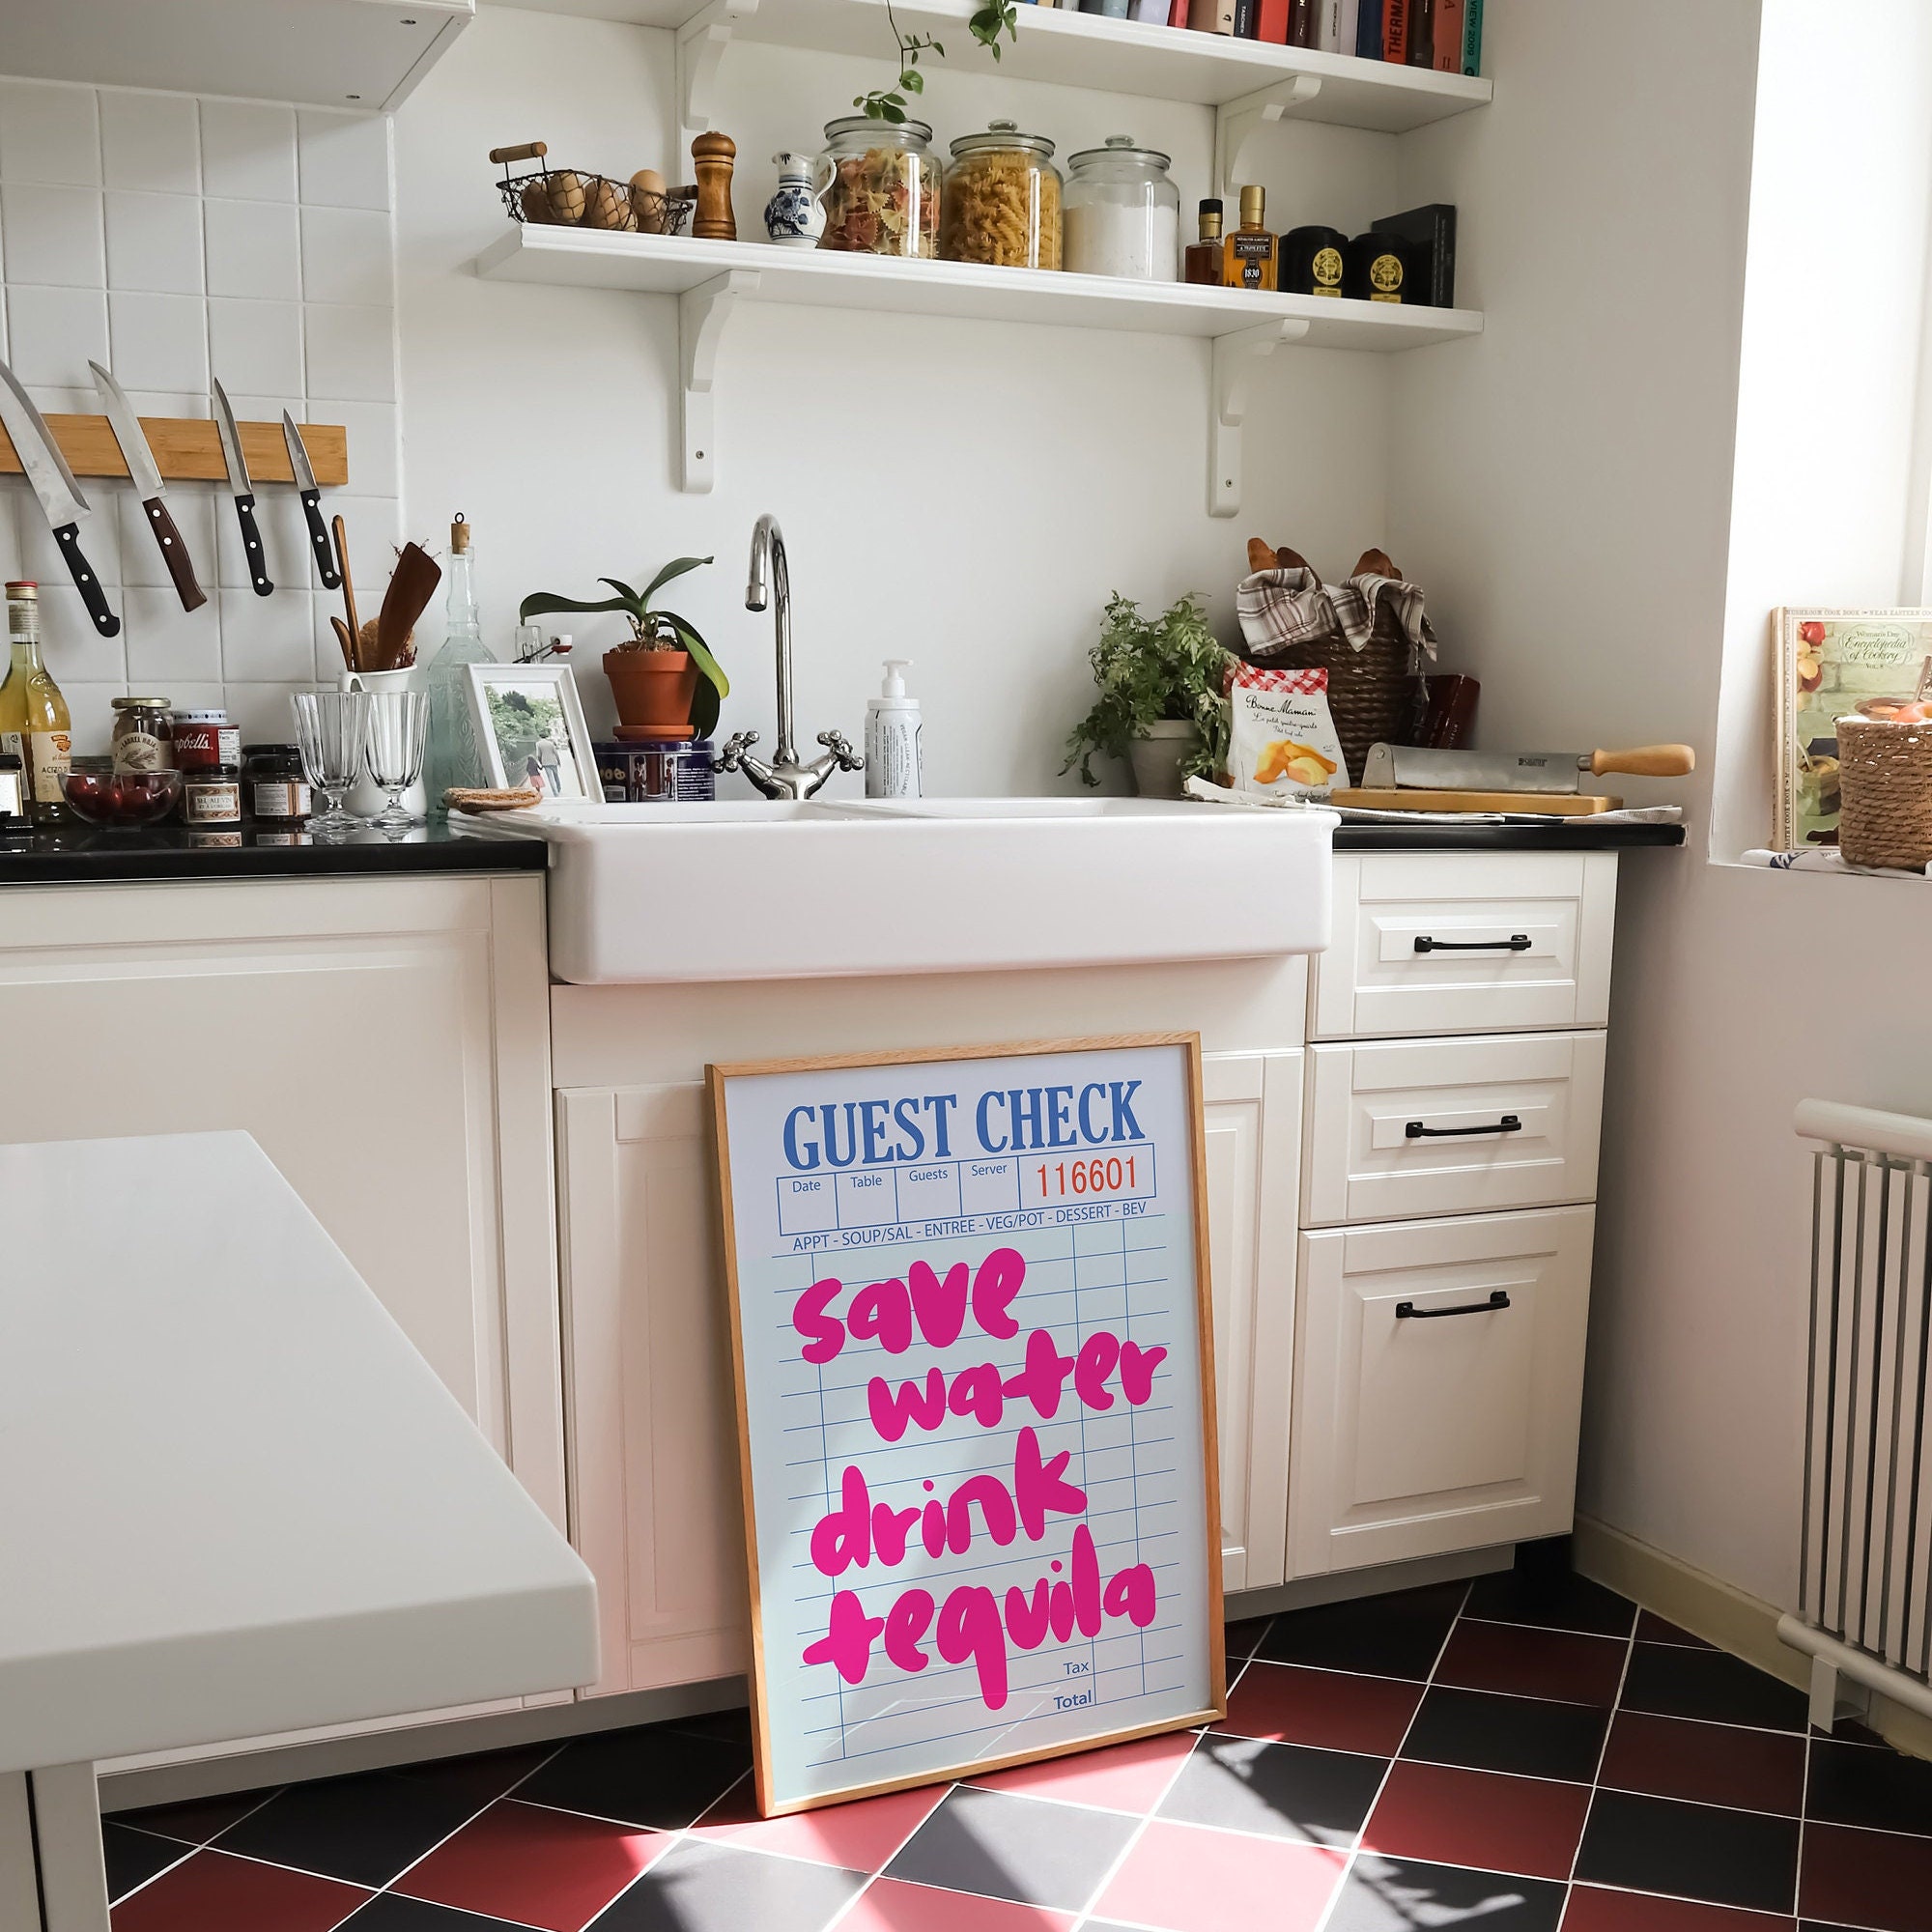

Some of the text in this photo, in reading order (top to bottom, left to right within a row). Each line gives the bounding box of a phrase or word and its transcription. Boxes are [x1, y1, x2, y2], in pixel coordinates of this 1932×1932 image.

[1466, 30, 1476, 56] 2009
[1844, 636, 1907, 651] Encyclopedia
[1862, 649, 1899, 665] Cookery
[1245, 695, 1317, 716] Bonne Maman
[783, 1081, 1146, 1170] GUEST CHECK
[909, 1168, 949, 1182] Guests
[971, 1163, 1008, 1177] Server
[1037, 1156, 1136, 1197] 116601
[792, 1179, 821, 1193] Date
[850, 1175, 882, 1188] Table
[792, 1235, 830, 1251] APPT
[842, 1226, 913, 1247] SOUP/SAL
[924, 1219, 976, 1237] ENTREE
[985, 1211, 1044, 1231] VEG/POT
[1056, 1205, 1111, 1223] DESSERT
[1122, 1201, 1147, 1216] BEV
[793, 1248, 1025, 1364] save
[867, 1329, 1167, 1441] water
[810, 1426, 1088, 1577] drink
[803, 1524, 1156, 1710] tequila
[1063, 1660, 1090, 1675] Tax
[1054, 1689, 1093, 1710] Total
